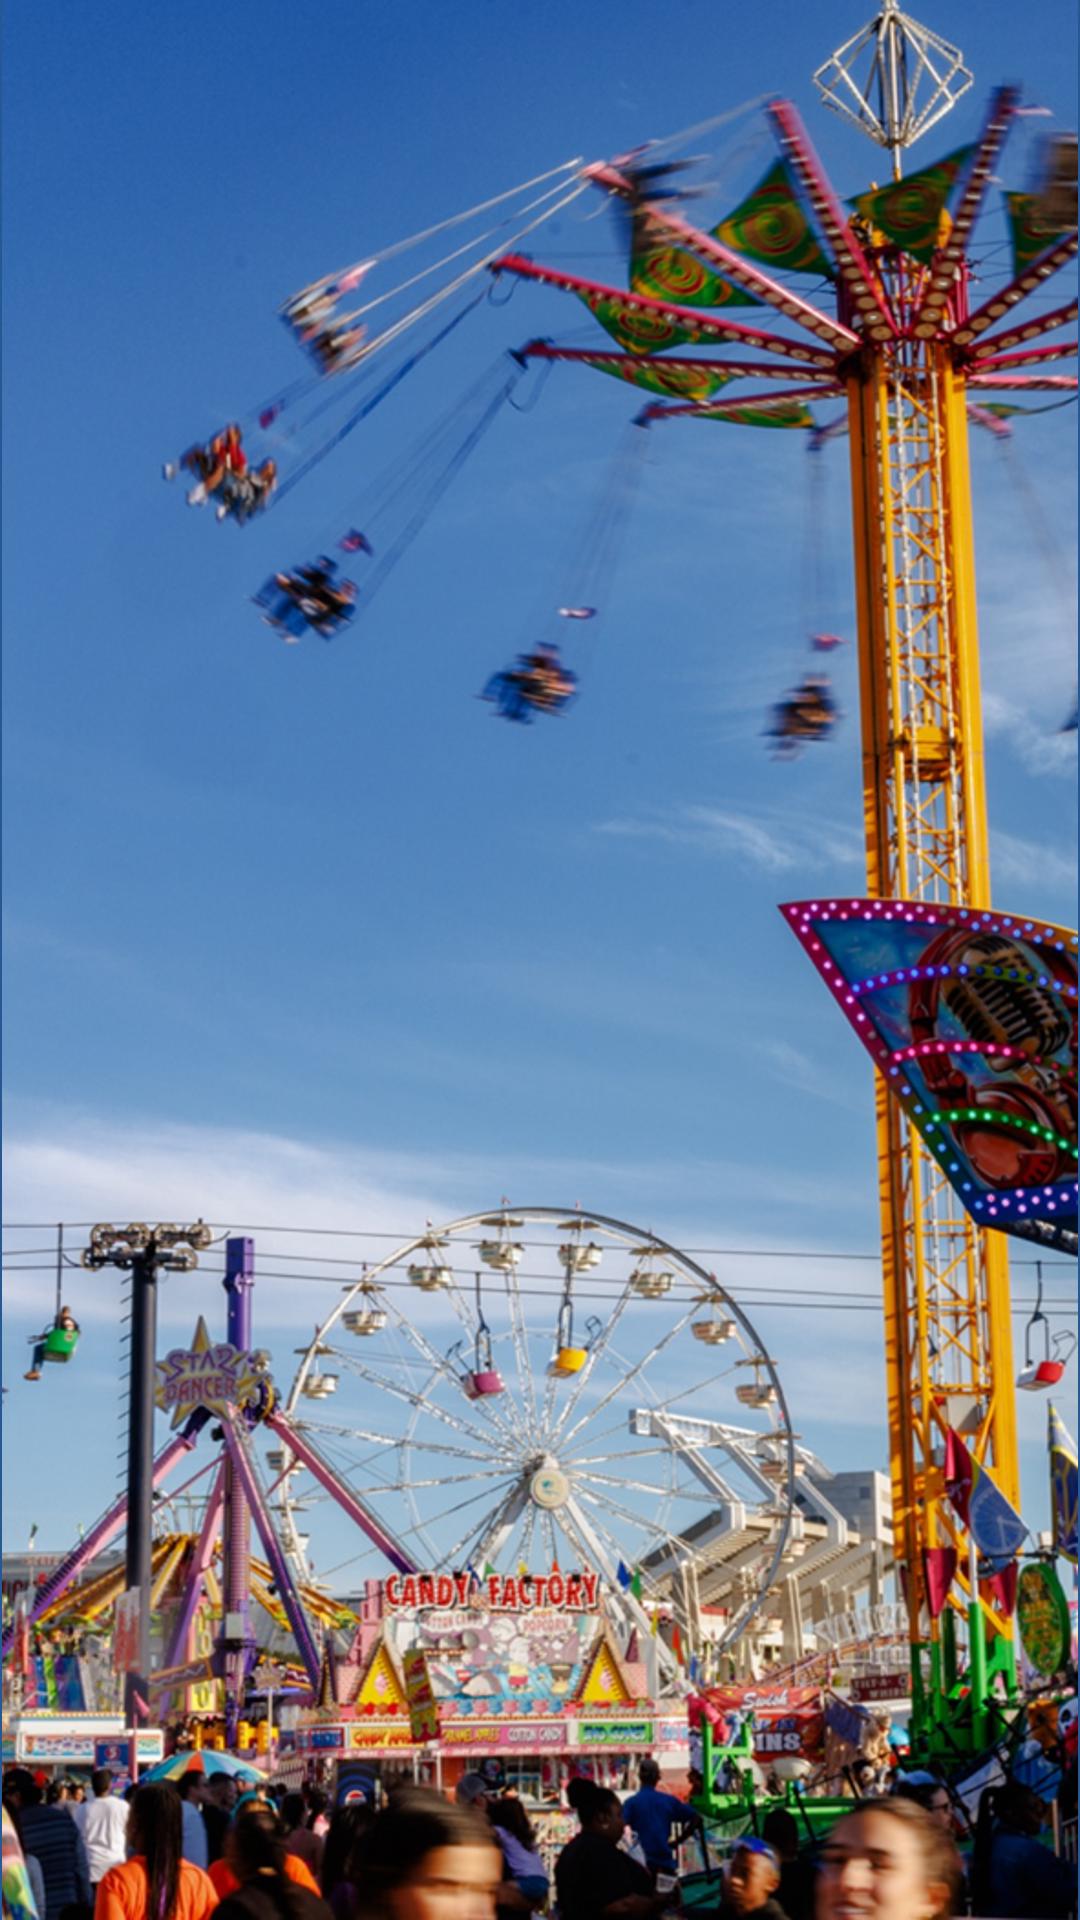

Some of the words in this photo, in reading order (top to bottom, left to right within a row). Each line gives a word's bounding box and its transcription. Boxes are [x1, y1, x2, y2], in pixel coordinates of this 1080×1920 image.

[164, 1376, 237, 1403] DANCER
[385, 1573, 470, 1607] CANDY
[486, 1574, 599, 1609] FACTORY
[755, 1733, 801, 1752] INS
